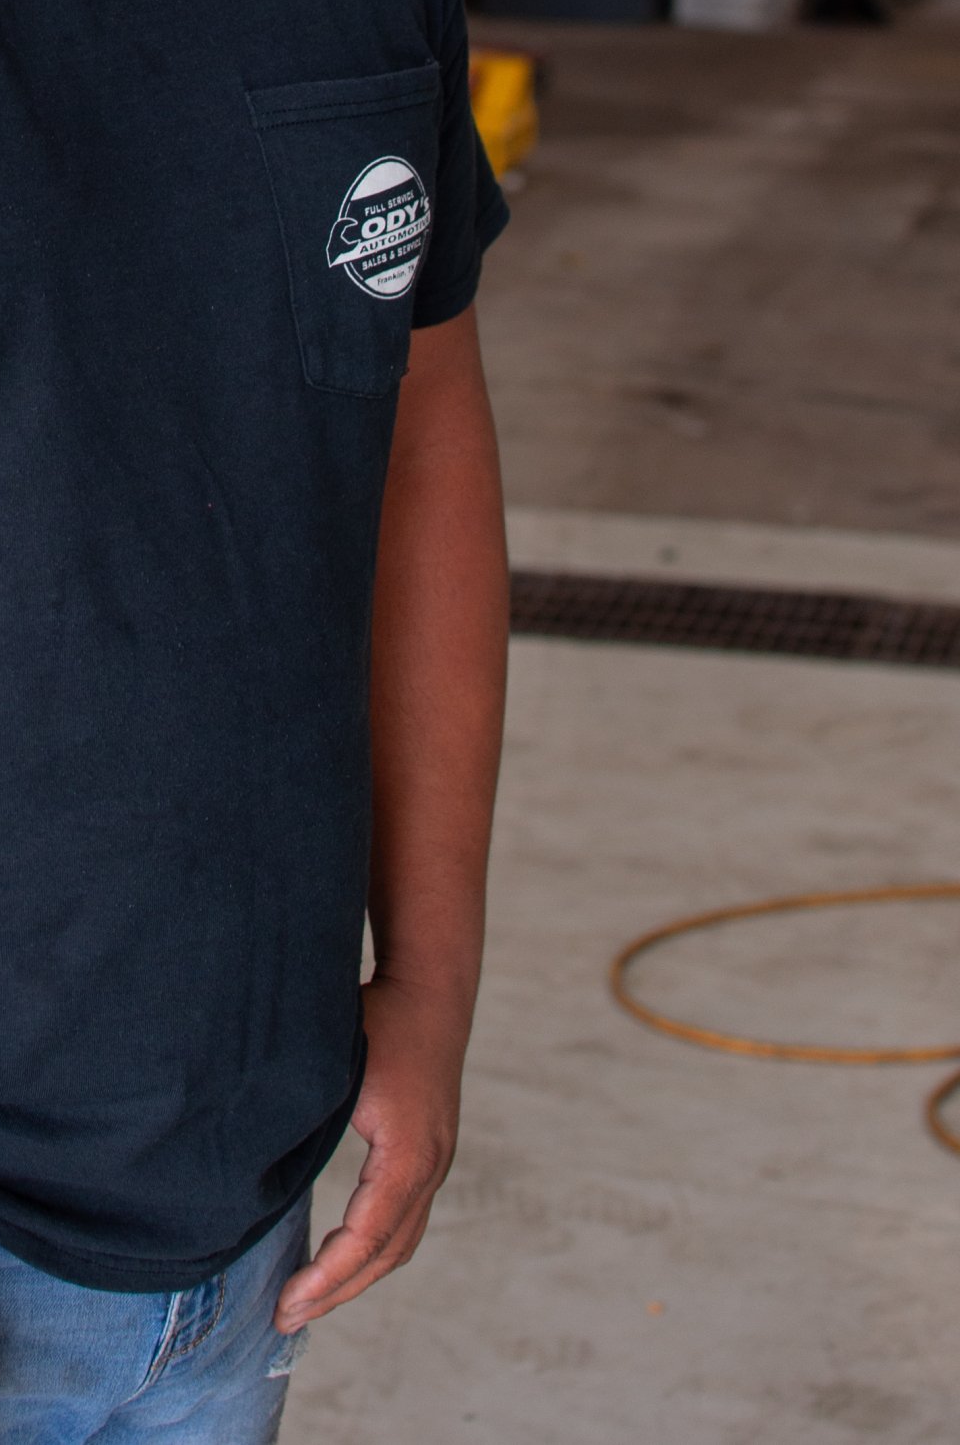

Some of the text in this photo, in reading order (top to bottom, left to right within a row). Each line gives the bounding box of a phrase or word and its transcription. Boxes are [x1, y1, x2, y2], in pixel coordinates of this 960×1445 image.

[365, 189, 415, 216] FULL SERVICE
[362, 237, 422, 270] SALES & SERVICE
